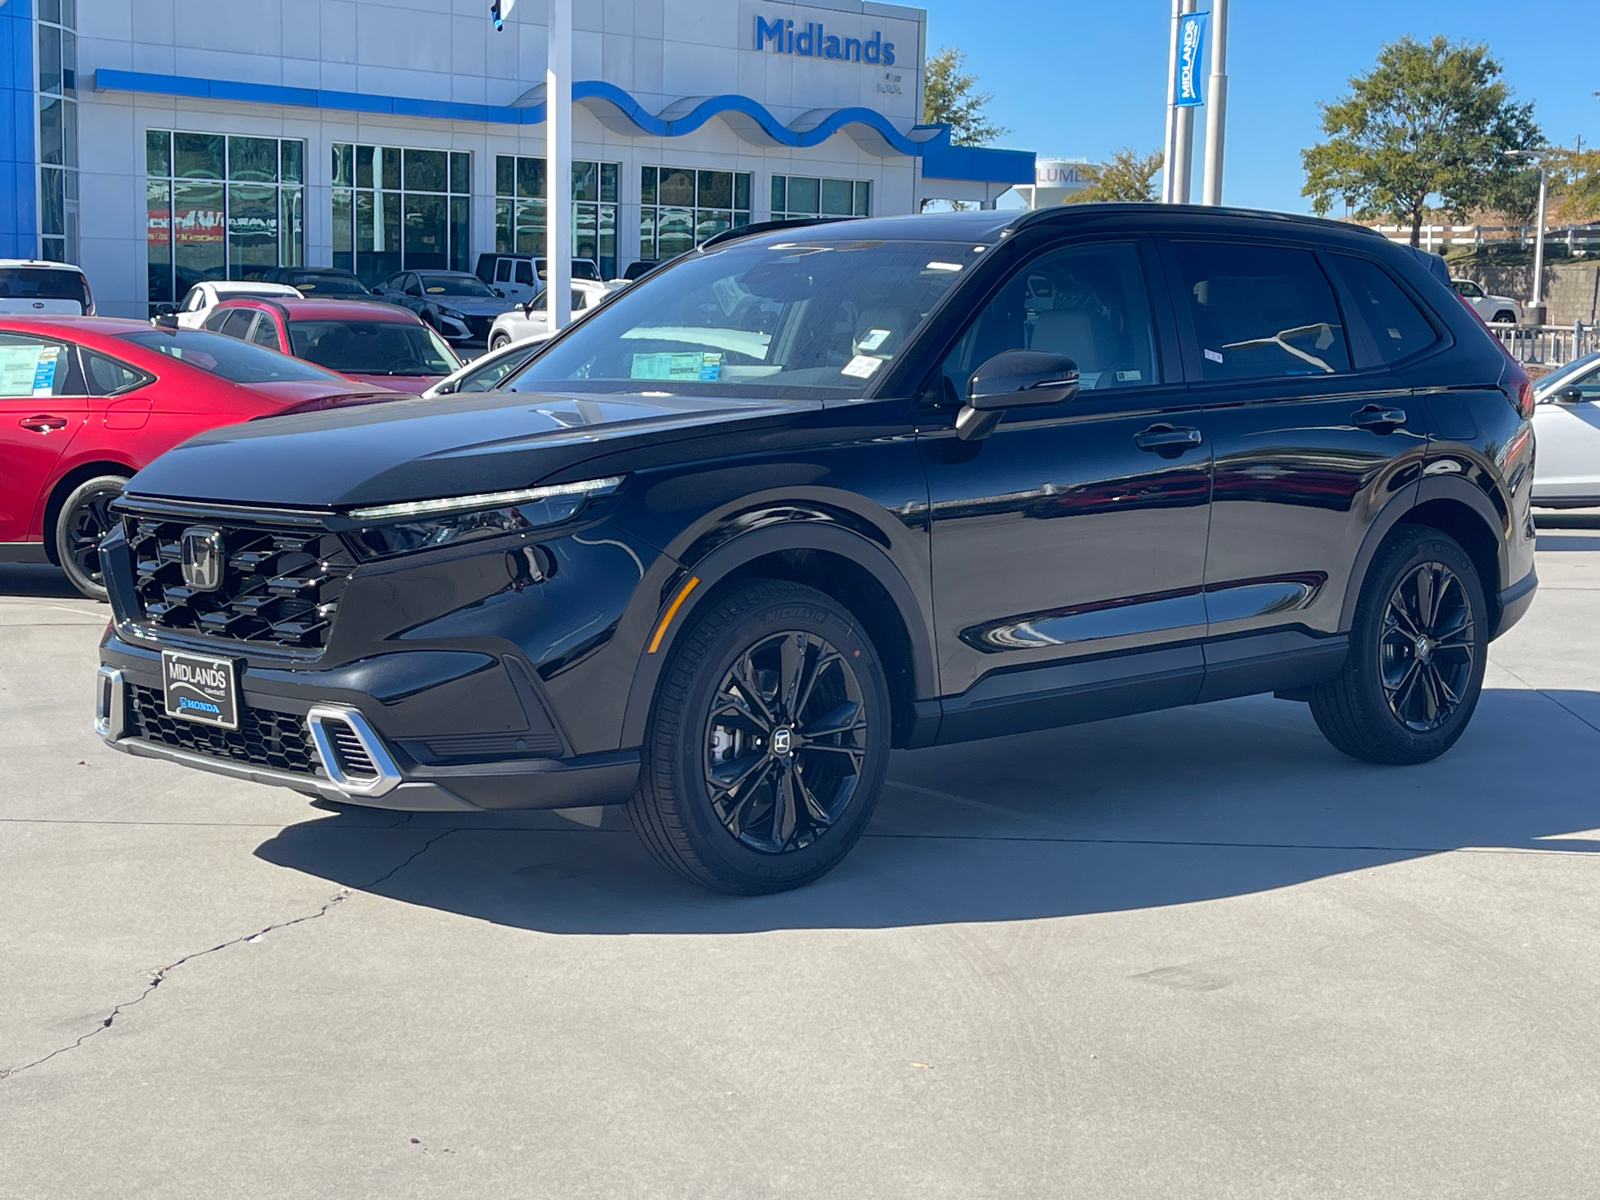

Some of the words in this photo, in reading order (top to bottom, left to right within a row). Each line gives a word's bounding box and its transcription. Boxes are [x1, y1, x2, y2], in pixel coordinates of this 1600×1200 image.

[754, 15, 896, 66] Midlands
[1181, 20, 1195, 98] MIDLANDS
[765, 607, 826, 623] MICHELIN
[169, 662, 226, 688] MIDLANDS
[187, 700, 220, 713] HONDA
